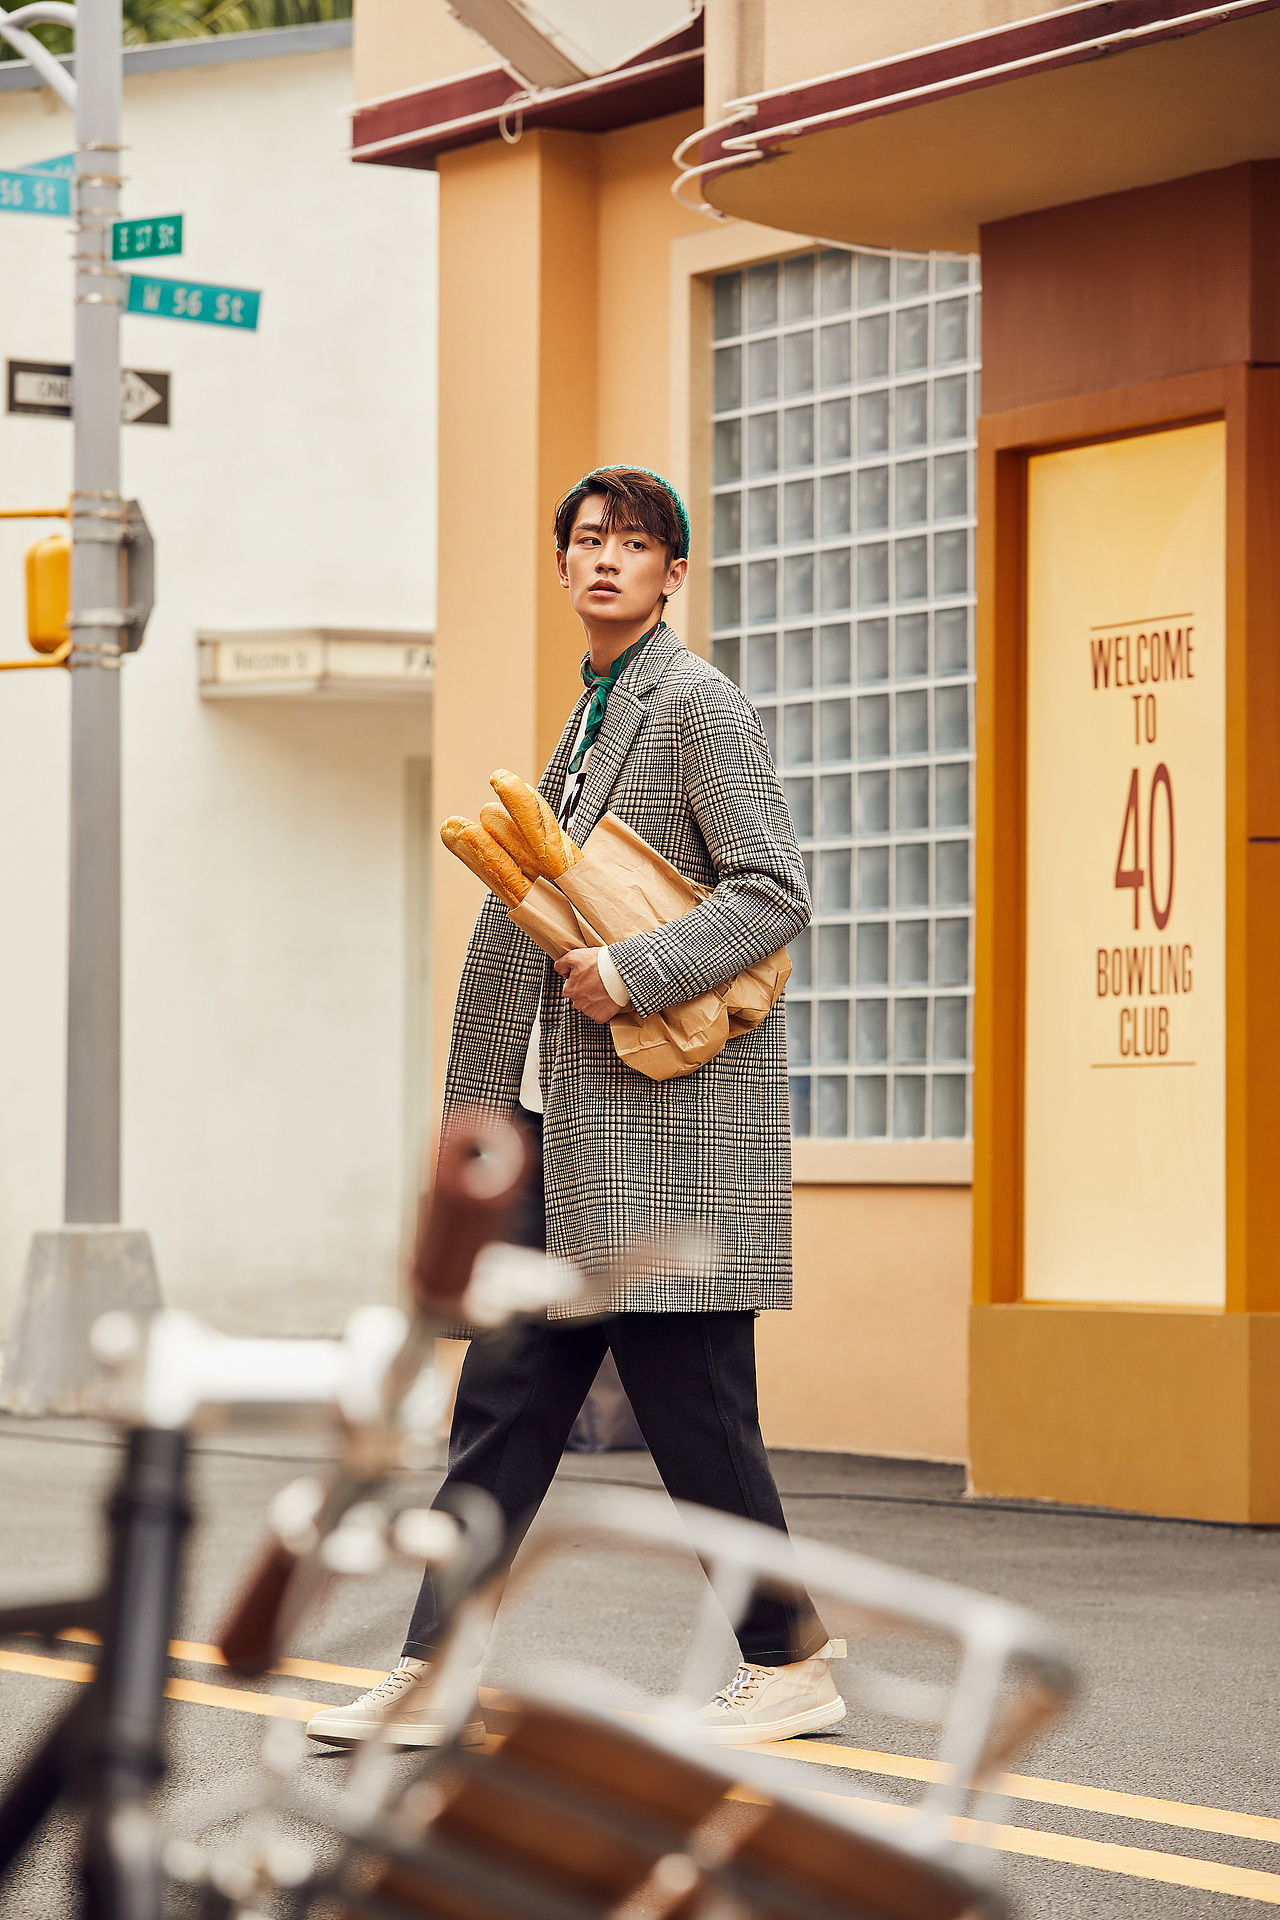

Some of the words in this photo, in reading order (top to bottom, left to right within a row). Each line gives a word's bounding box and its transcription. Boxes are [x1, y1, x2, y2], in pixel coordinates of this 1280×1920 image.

[33, 181, 57, 209] St
[172, 287, 202, 317] 56
[214, 293, 244, 323] St
[1091, 627, 1194, 690] WELCOME
[1132, 693, 1157, 746] TO
[1115, 763, 1175, 931] 40
[1097, 944, 1192, 997] BOWLING
[1120, 1006, 1169, 1057] CLUB
